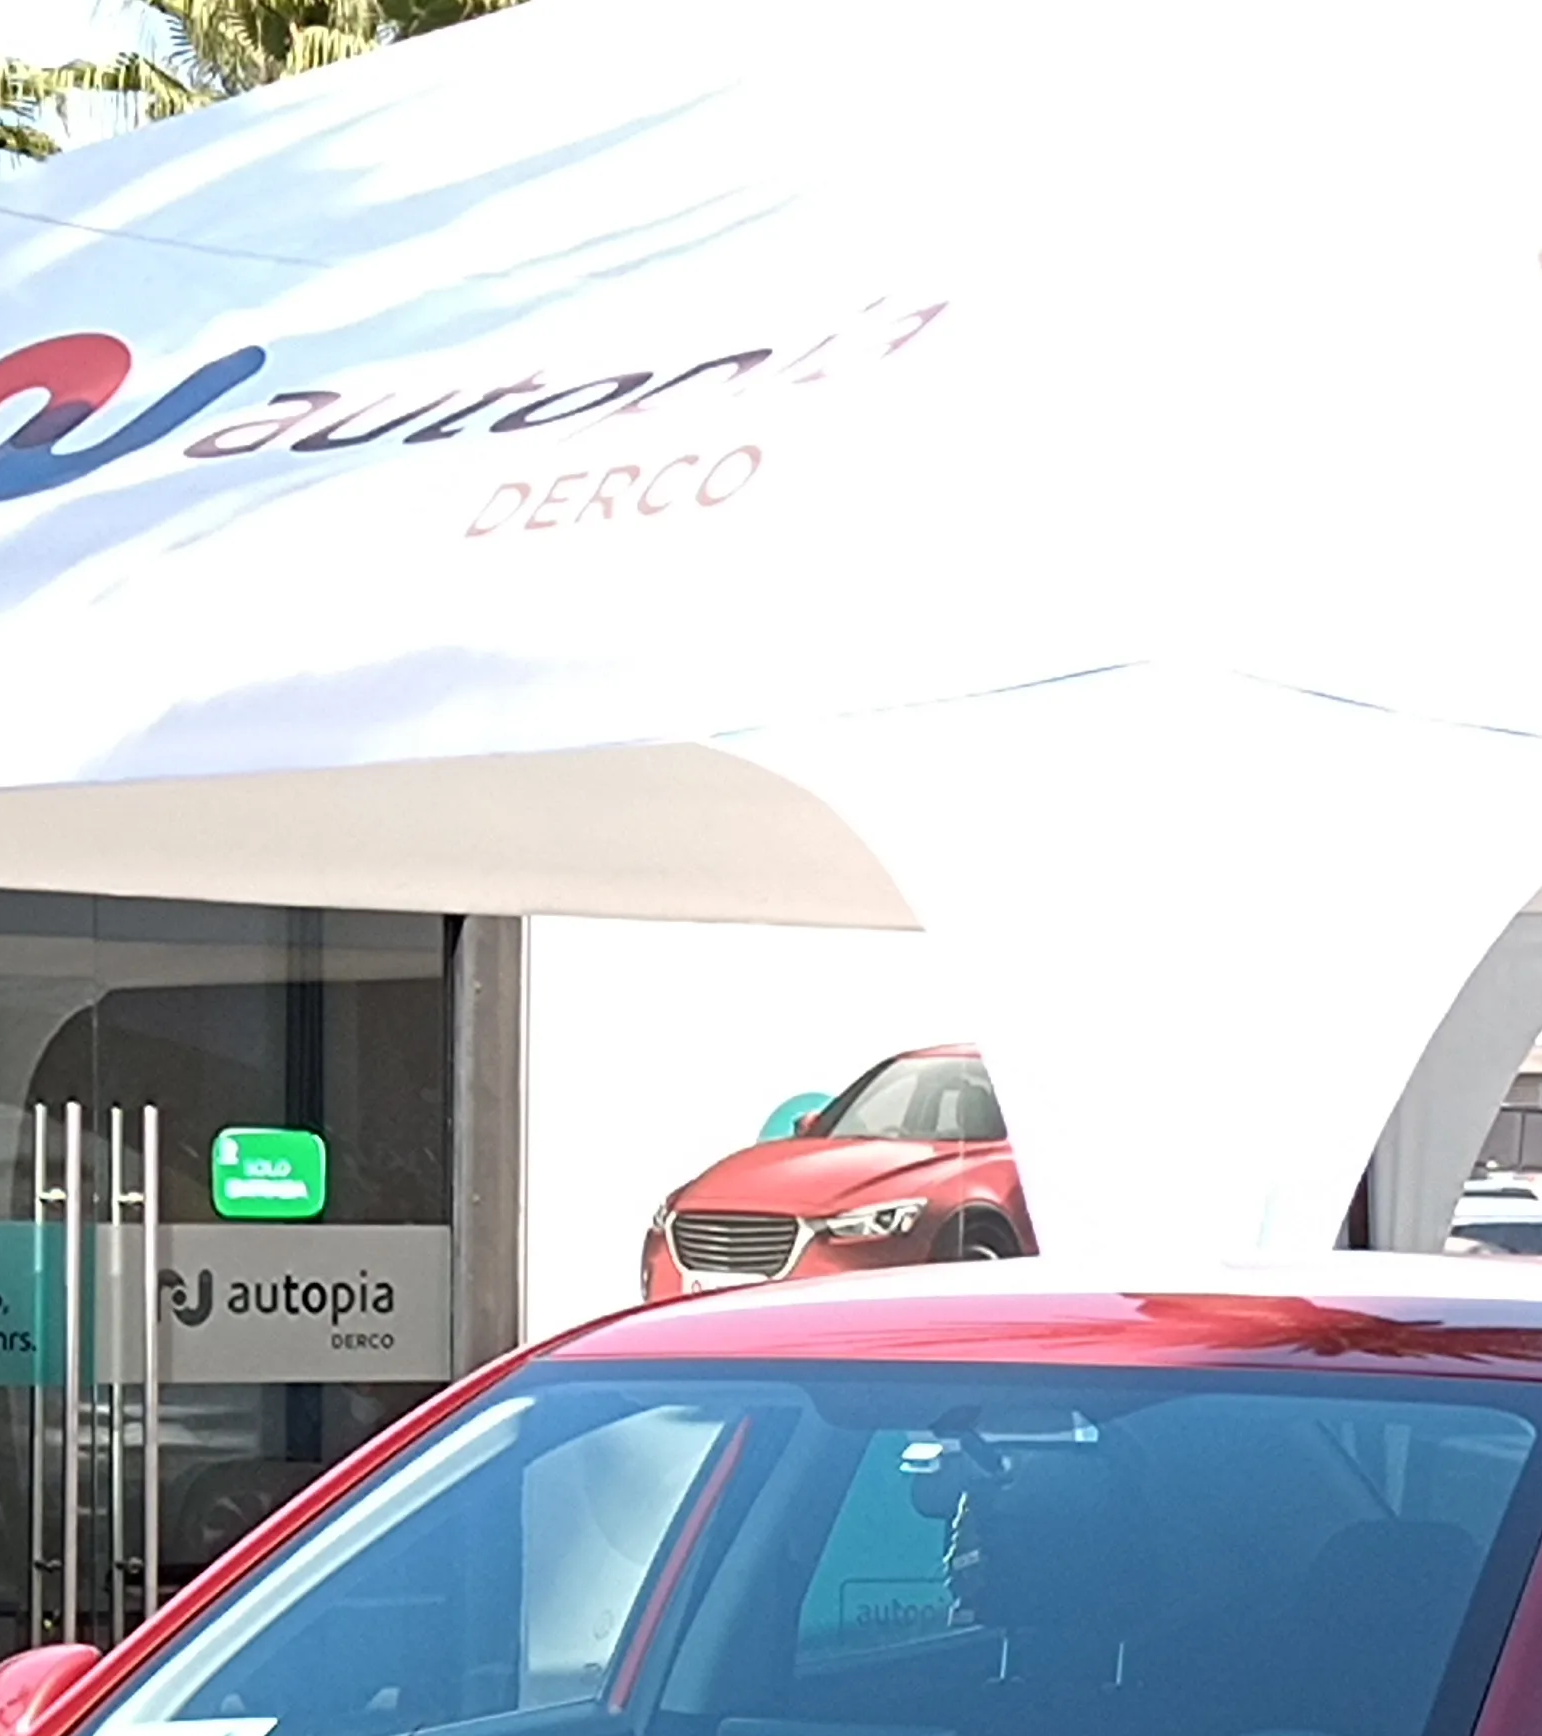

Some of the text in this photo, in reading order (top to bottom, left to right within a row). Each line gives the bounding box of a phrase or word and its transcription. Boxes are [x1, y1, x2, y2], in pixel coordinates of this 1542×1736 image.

[464, 444, 762, 538] DERCO
[227, 1269, 394, 1326] autopia
[330, 1333, 394, 1349] DERCO
